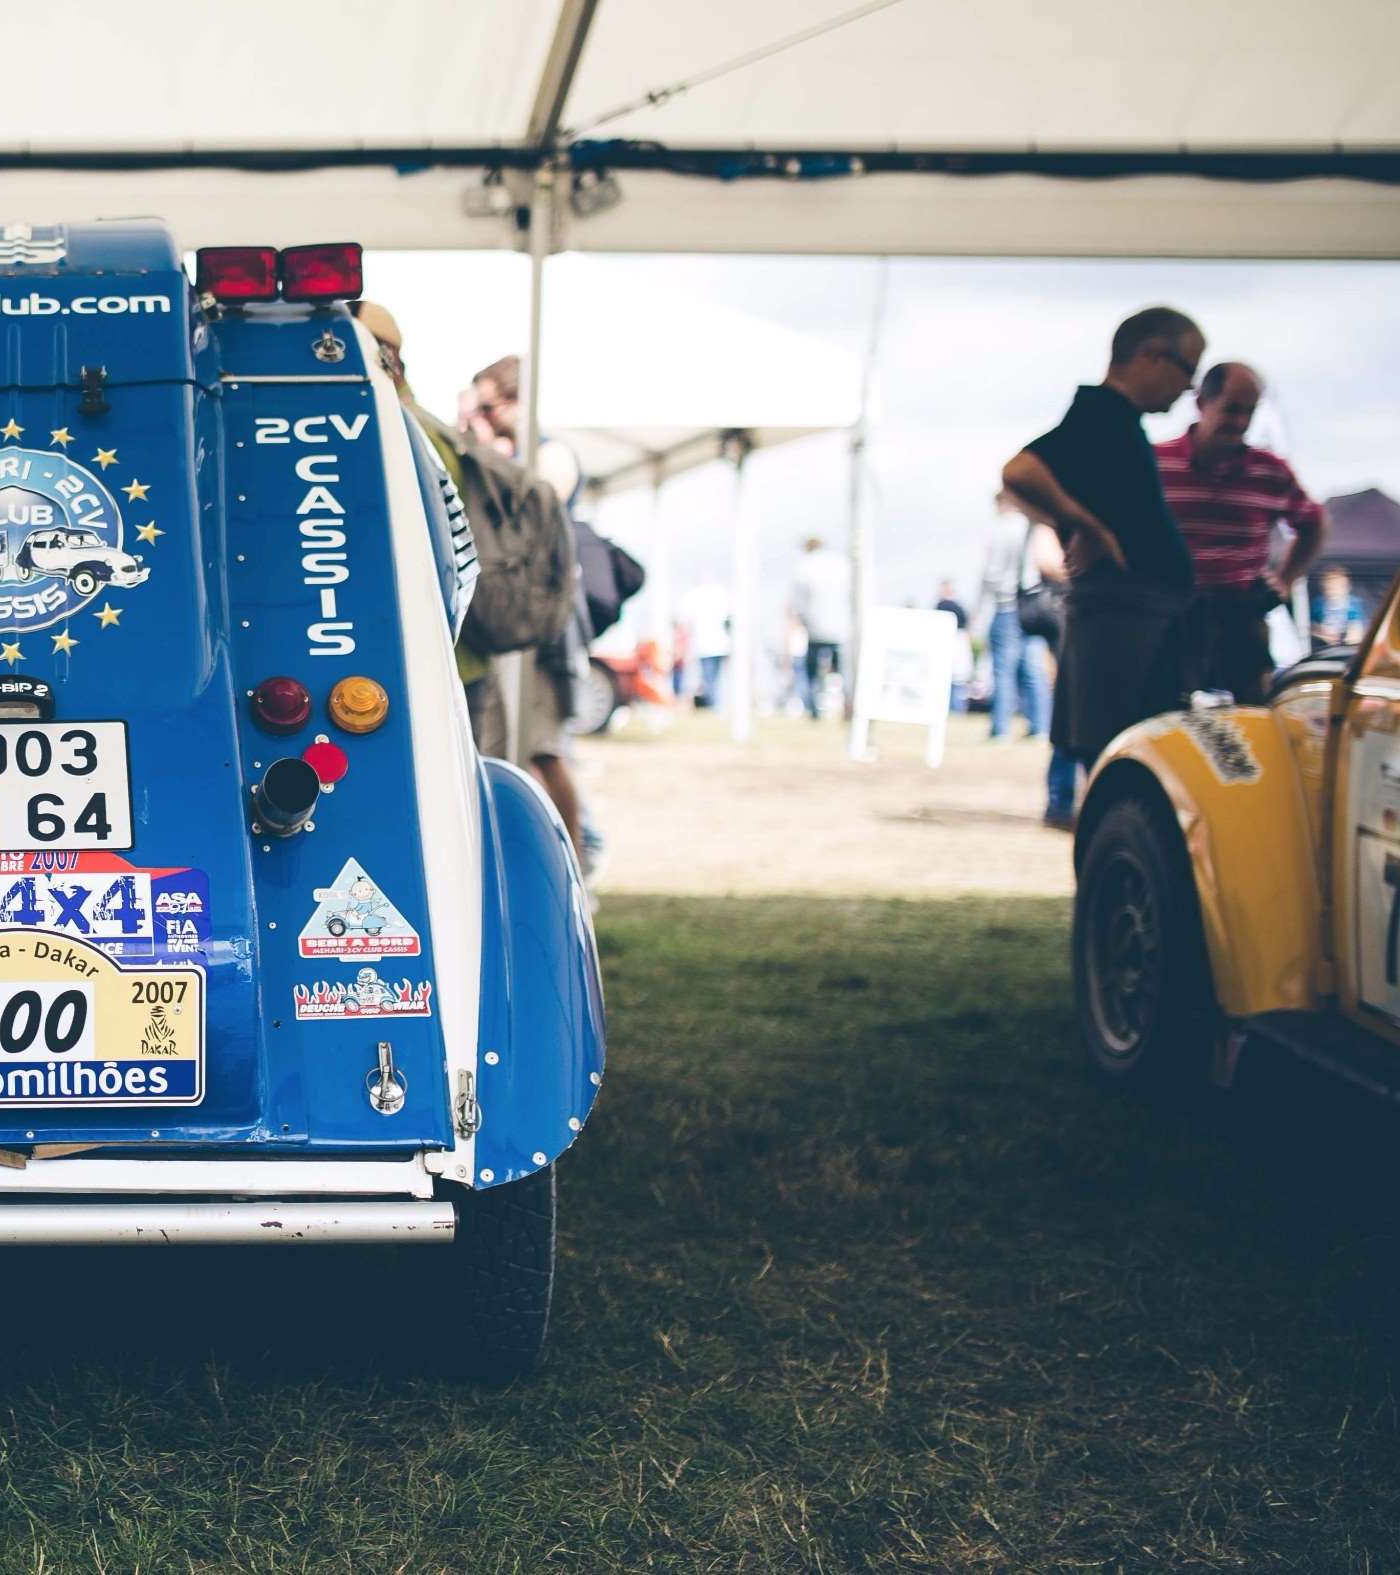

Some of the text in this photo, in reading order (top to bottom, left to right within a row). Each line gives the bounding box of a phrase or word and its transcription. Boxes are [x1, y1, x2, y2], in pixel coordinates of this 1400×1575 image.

[254, 413, 370, 444] 2CV
[54, 474, 108, 529] 2CV
[295, 455, 357, 657] CASSIS
[33, 684, 48, 697] 2
[27, 793, 112, 842] 64
[155, 892, 203, 906] ASA
[166, 919, 198, 934] FIA
[34, 942, 99, 979] Dakar
[132, 981, 187, 1004] 2007
